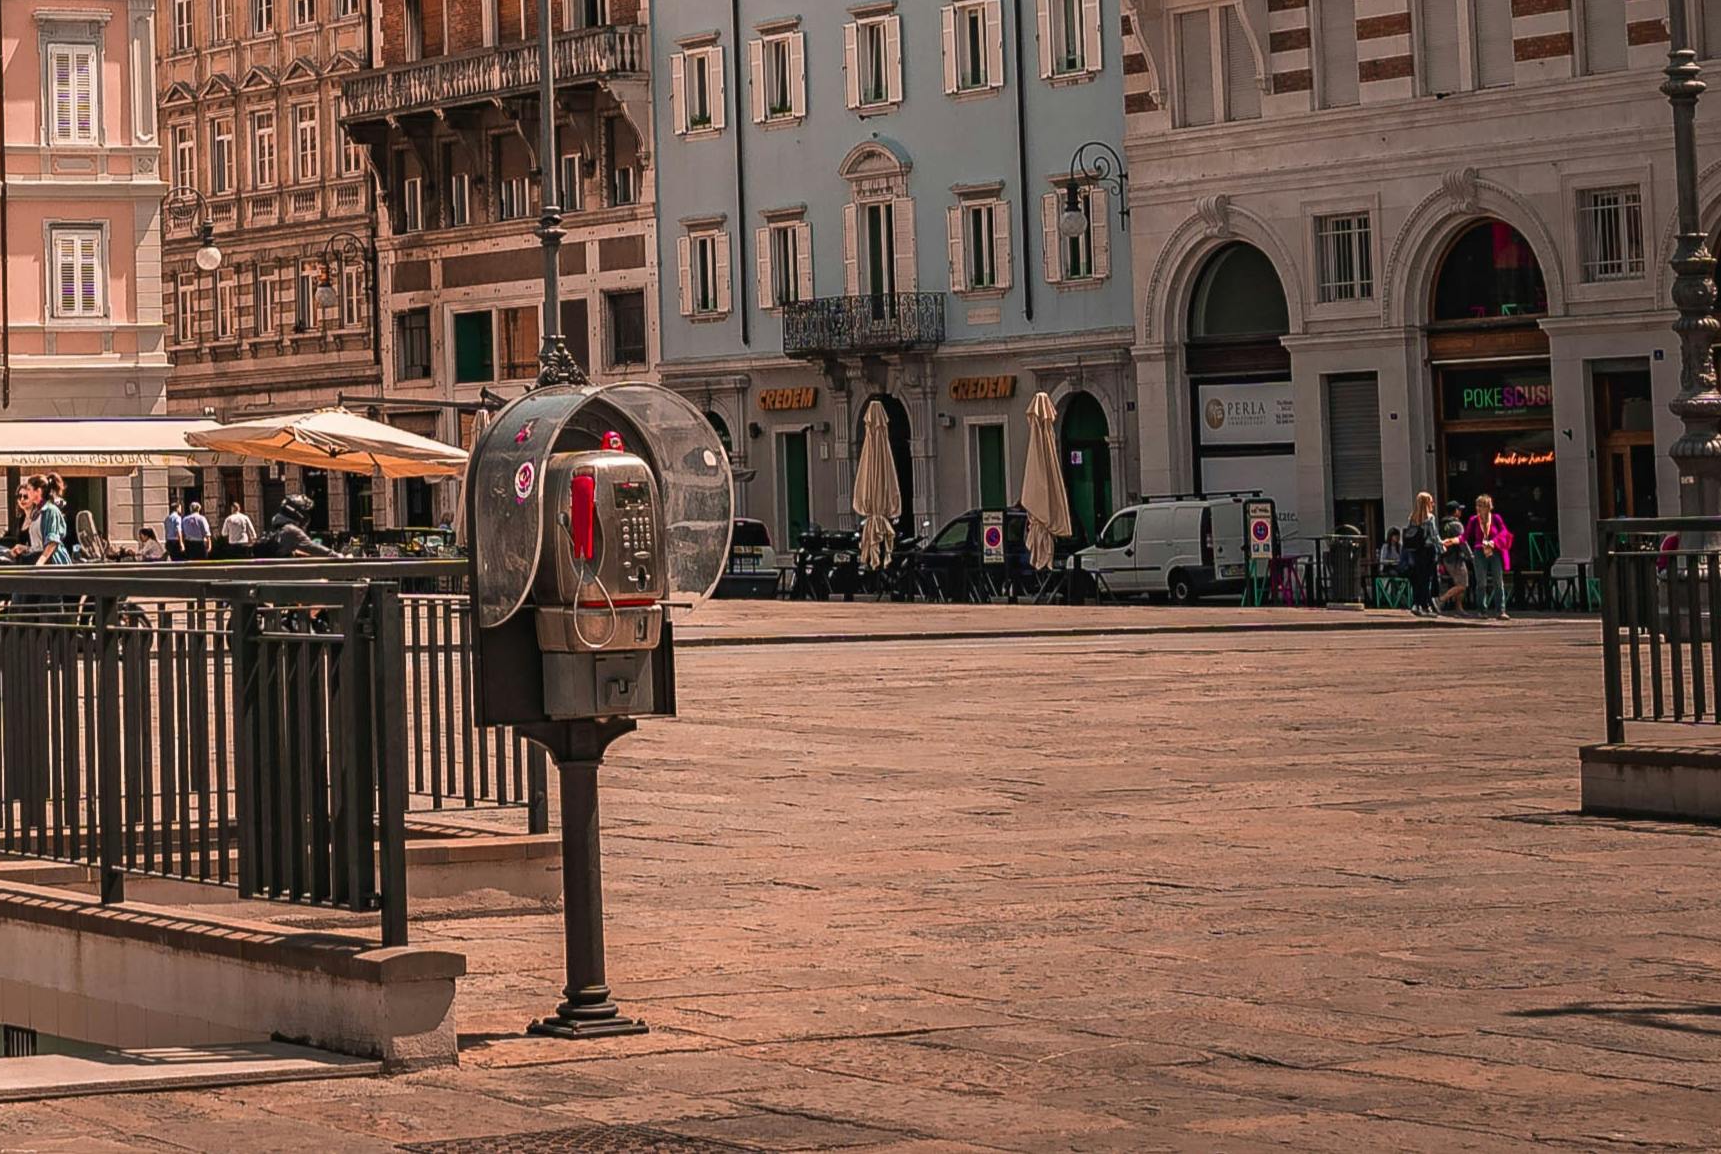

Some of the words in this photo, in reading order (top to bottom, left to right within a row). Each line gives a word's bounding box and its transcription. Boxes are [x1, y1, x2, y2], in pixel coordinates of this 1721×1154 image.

[949, 376, 1012, 399] CREDEM
[757, 388, 814, 410] CREDEM
[1227, 401, 1266, 415] PERLA
[89, 453, 125, 464] RISTO
[129, 453, 153, 464] BAR
